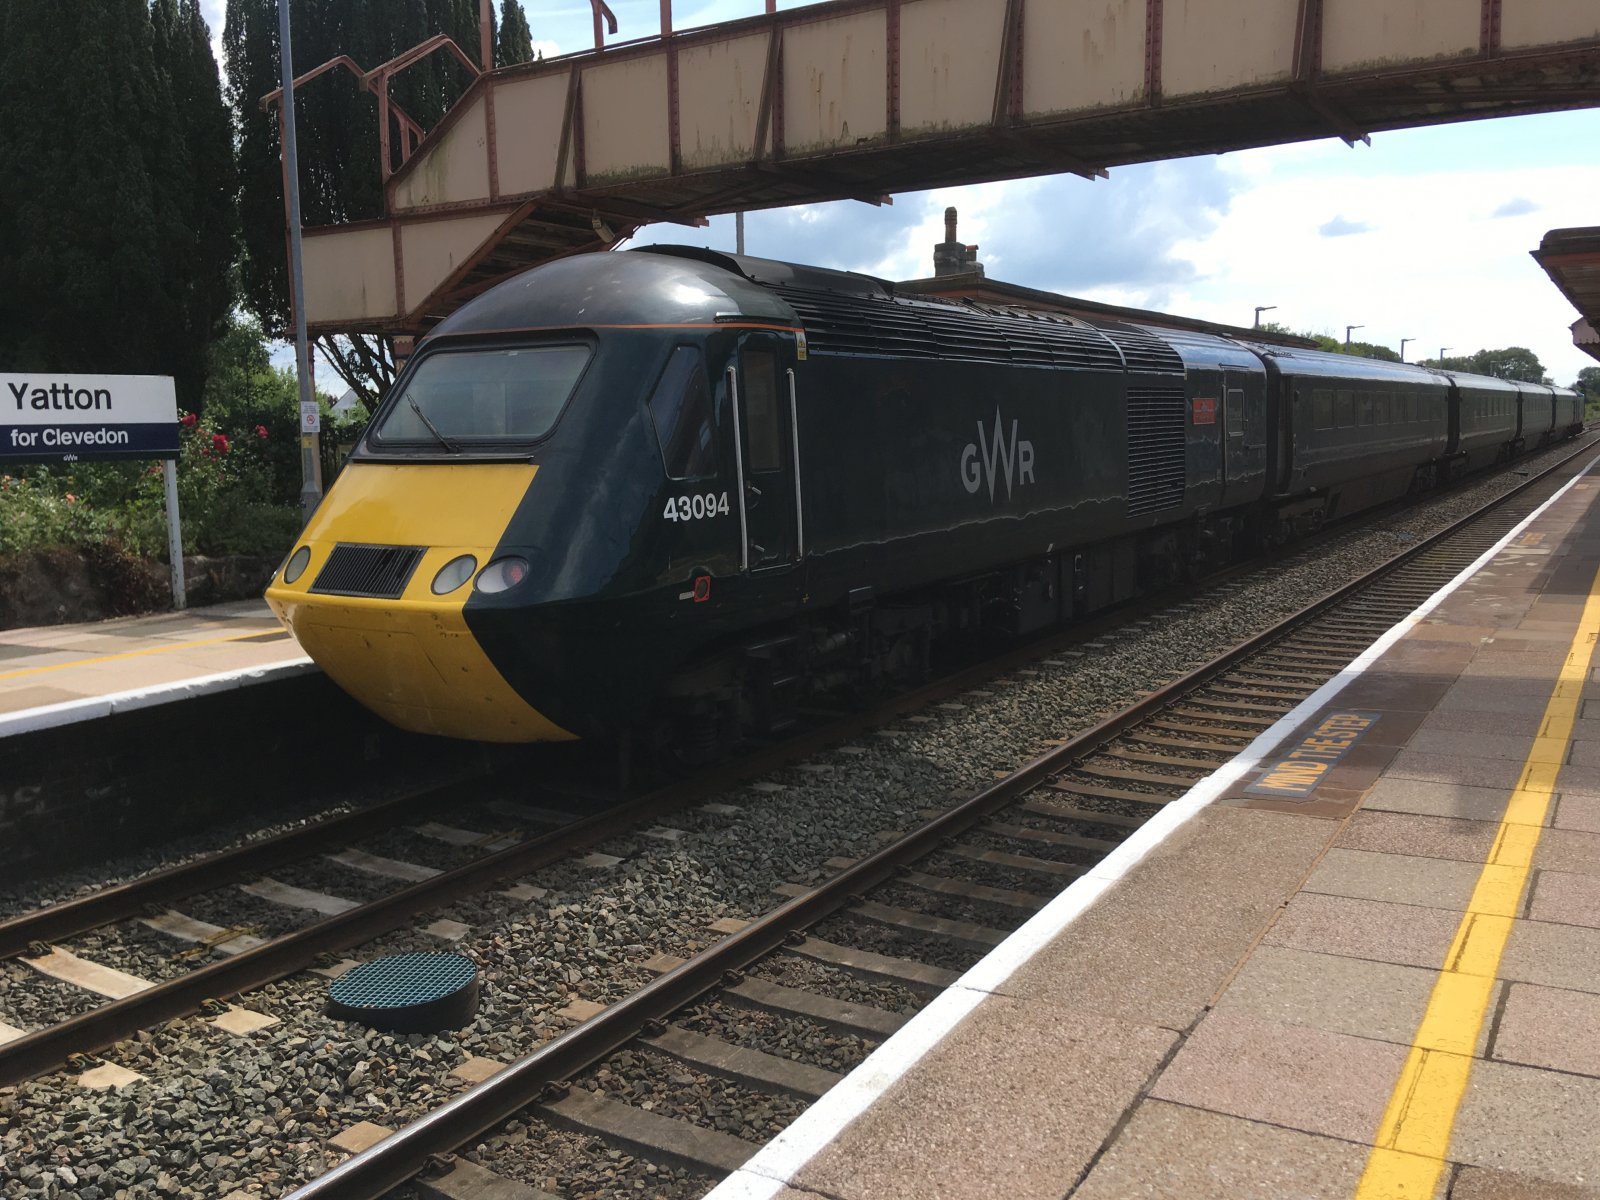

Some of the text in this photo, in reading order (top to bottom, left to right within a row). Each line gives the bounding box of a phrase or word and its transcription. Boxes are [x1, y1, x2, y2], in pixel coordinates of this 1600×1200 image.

[8, 382, 112, 410] Yatton
[10, 428, 129, 447] for Clevedon
[960, 404, 1035, 503] GWR
[663, 492, 729, 522] 43094
[1256, 714, 1372, 791] MIND THE STEP
